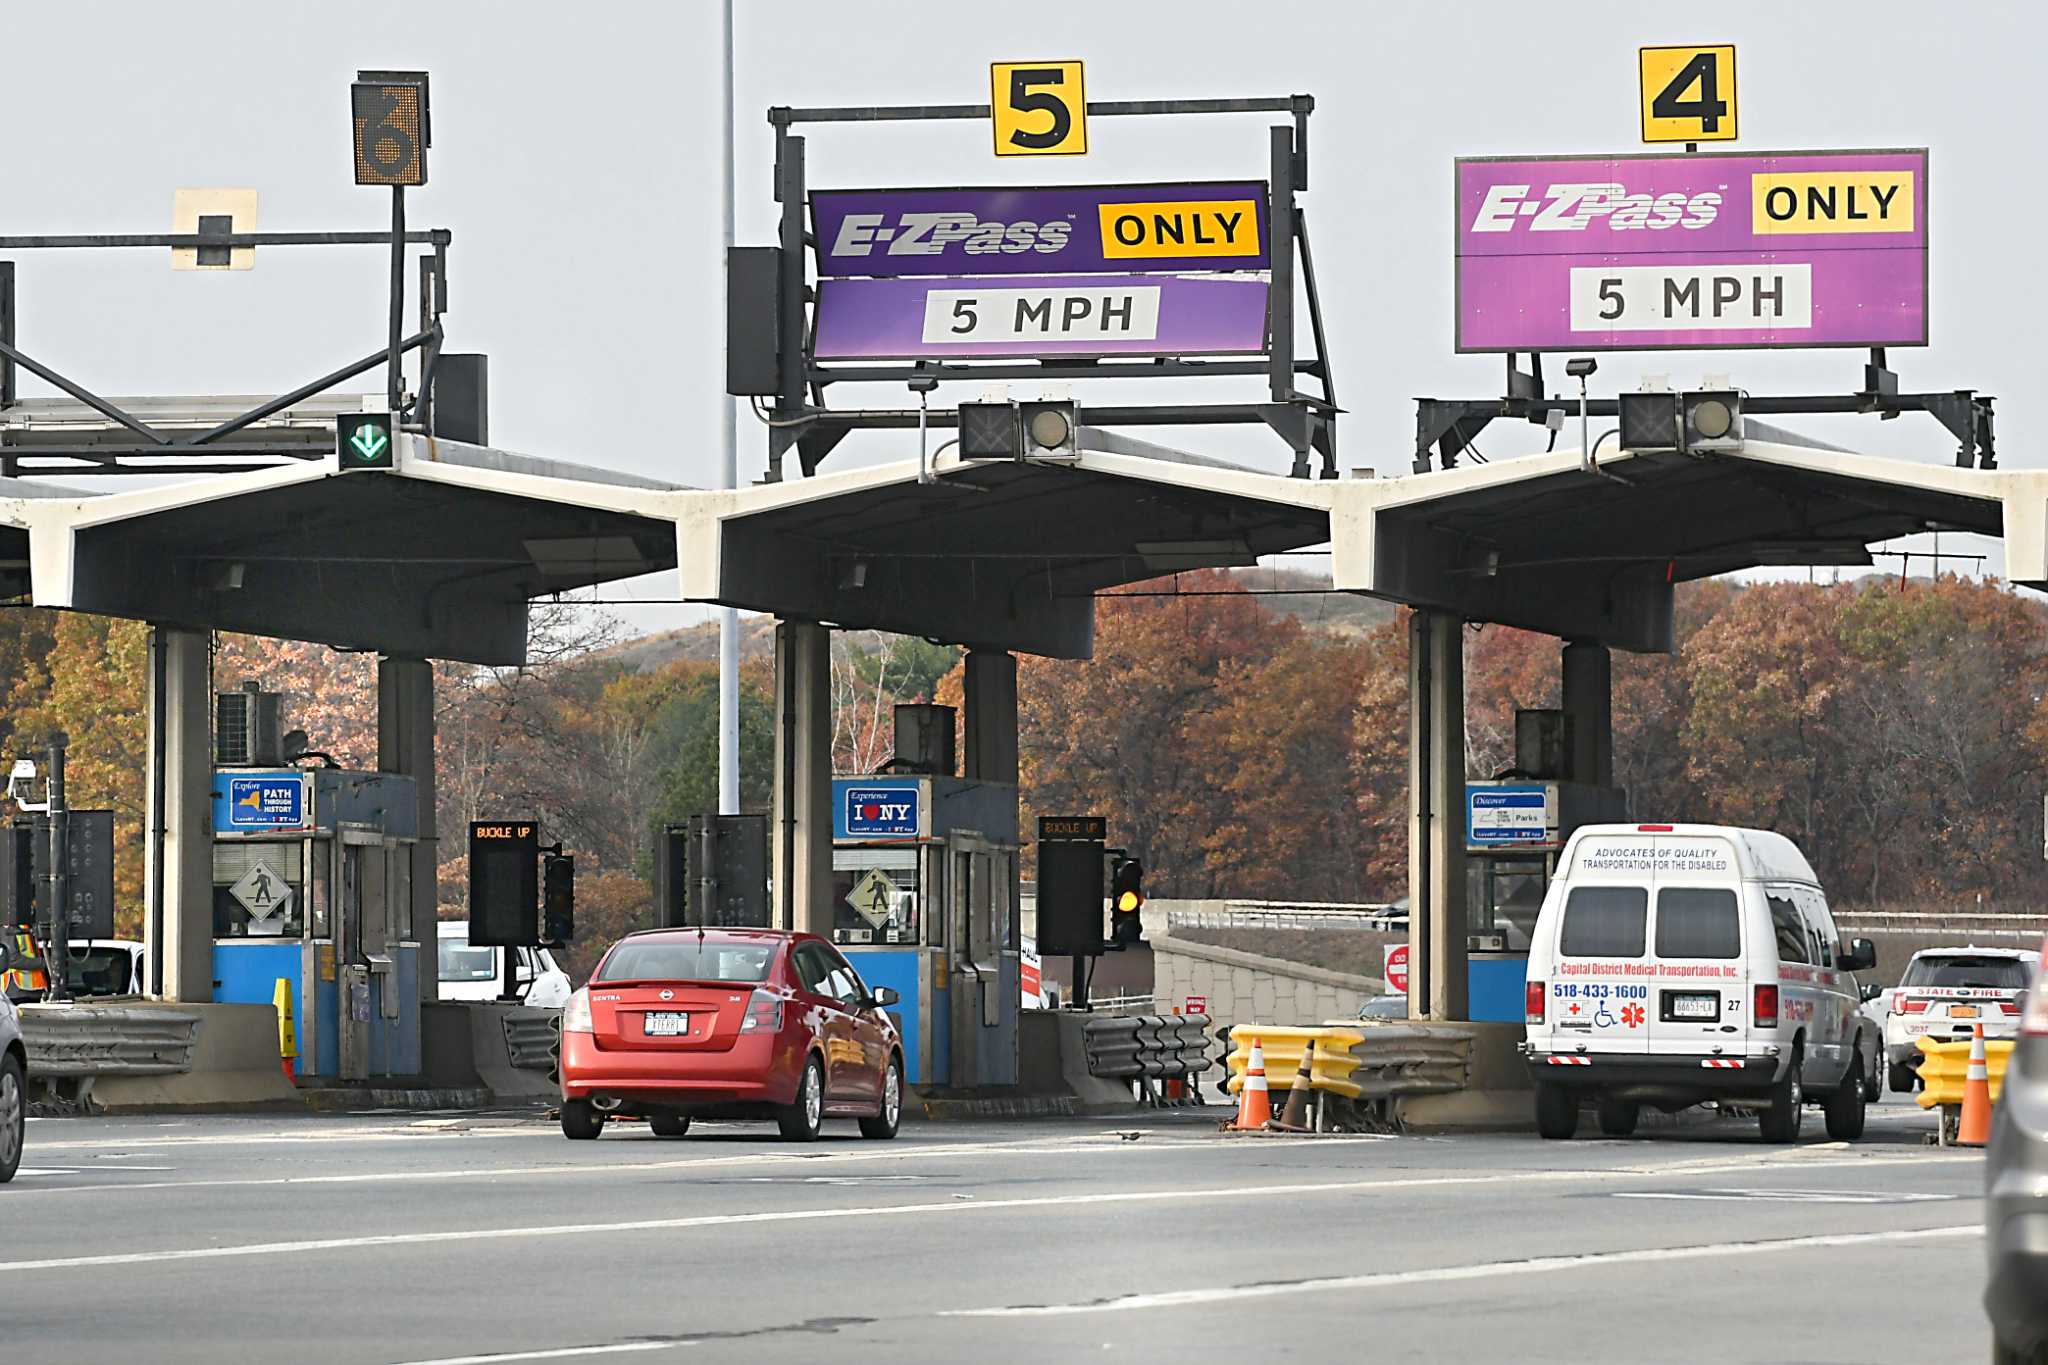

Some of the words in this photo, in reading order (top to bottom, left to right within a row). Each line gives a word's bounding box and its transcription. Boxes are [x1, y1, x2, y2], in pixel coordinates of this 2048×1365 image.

[1652, 53, 1727, 133] 4
[1009, 68, 1071, 148] 5
[1470, 182, 1722, 232] E-ZPass
[1765, 185, 1899, 221] ONLY
[831, 212, 1072, 256] E-ZPass
[1114, 212, 1243, 246] ONLY
[1599, 279, 1625, 319] 5
[1663, 276, 1784, 318] MPH
[951, 300, 978, 334] 5
[1014, 296, 1133, 332] MPH
[264, 789, 292, 798] PATH
[850, 792, 888, 802] Experience
[1475, 797, 1506, 805] Discover
[854, 804, 864, 821] I
[879, 804, 911, 821] NY
[477, 827, 512, 838] BUCKLE
[517, 827, 530, 838] UP
[1044, 823, 1080, 833] BUCKLE
[1595, 848, 1655, 858] ADVOCATES
[1658, 849, 1671, 858] OF
[1674, 849, 1717, 858] QUALITY
[1583, 859, 1651, 870] TRANSPORTATION
[1654, 860, 1669, 870] FOR
[1671, 860, 1686, 870] THE
[1688, 860, 1727, 871] DISABLED
[1561, 963, 1590, 975] Capital
[1592, 963, 1622, 975] District
[1624, 964, 1657, 976] Medical
[1723, 965, 1738, 977] Inc.
[1554, 984, 1647, 999] 518-433-1600
[1918, 988, 1953, 996] STATE
[1972, 989, 2002, 997] FIRE
[1728, 1000, 1741, 1011] 27
